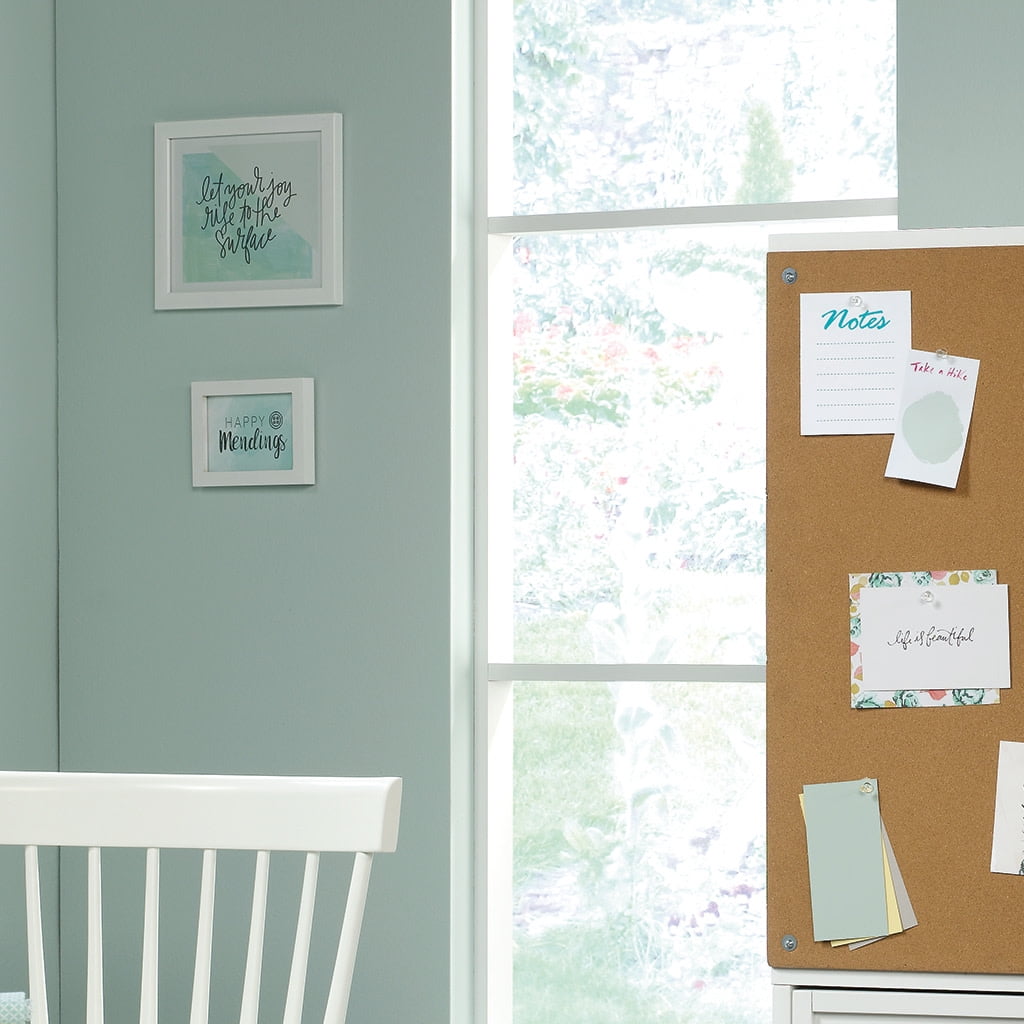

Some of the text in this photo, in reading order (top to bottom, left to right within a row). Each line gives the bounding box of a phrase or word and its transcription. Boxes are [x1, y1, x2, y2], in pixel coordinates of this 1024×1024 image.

[196, 166, 297, 209] let your joy
[240, 199, 251, 228] to
[252, 196, 281, 227] the
[821, 308, 891, 330] Notes
[911, 361, 935, 374] Take
[946, 367, 968, 381] Hike
[225, 415, 265, 428] HAPPY
[219, 428, 288, 459] Mendings
[887, 626, 975, 650] life is beautiful
